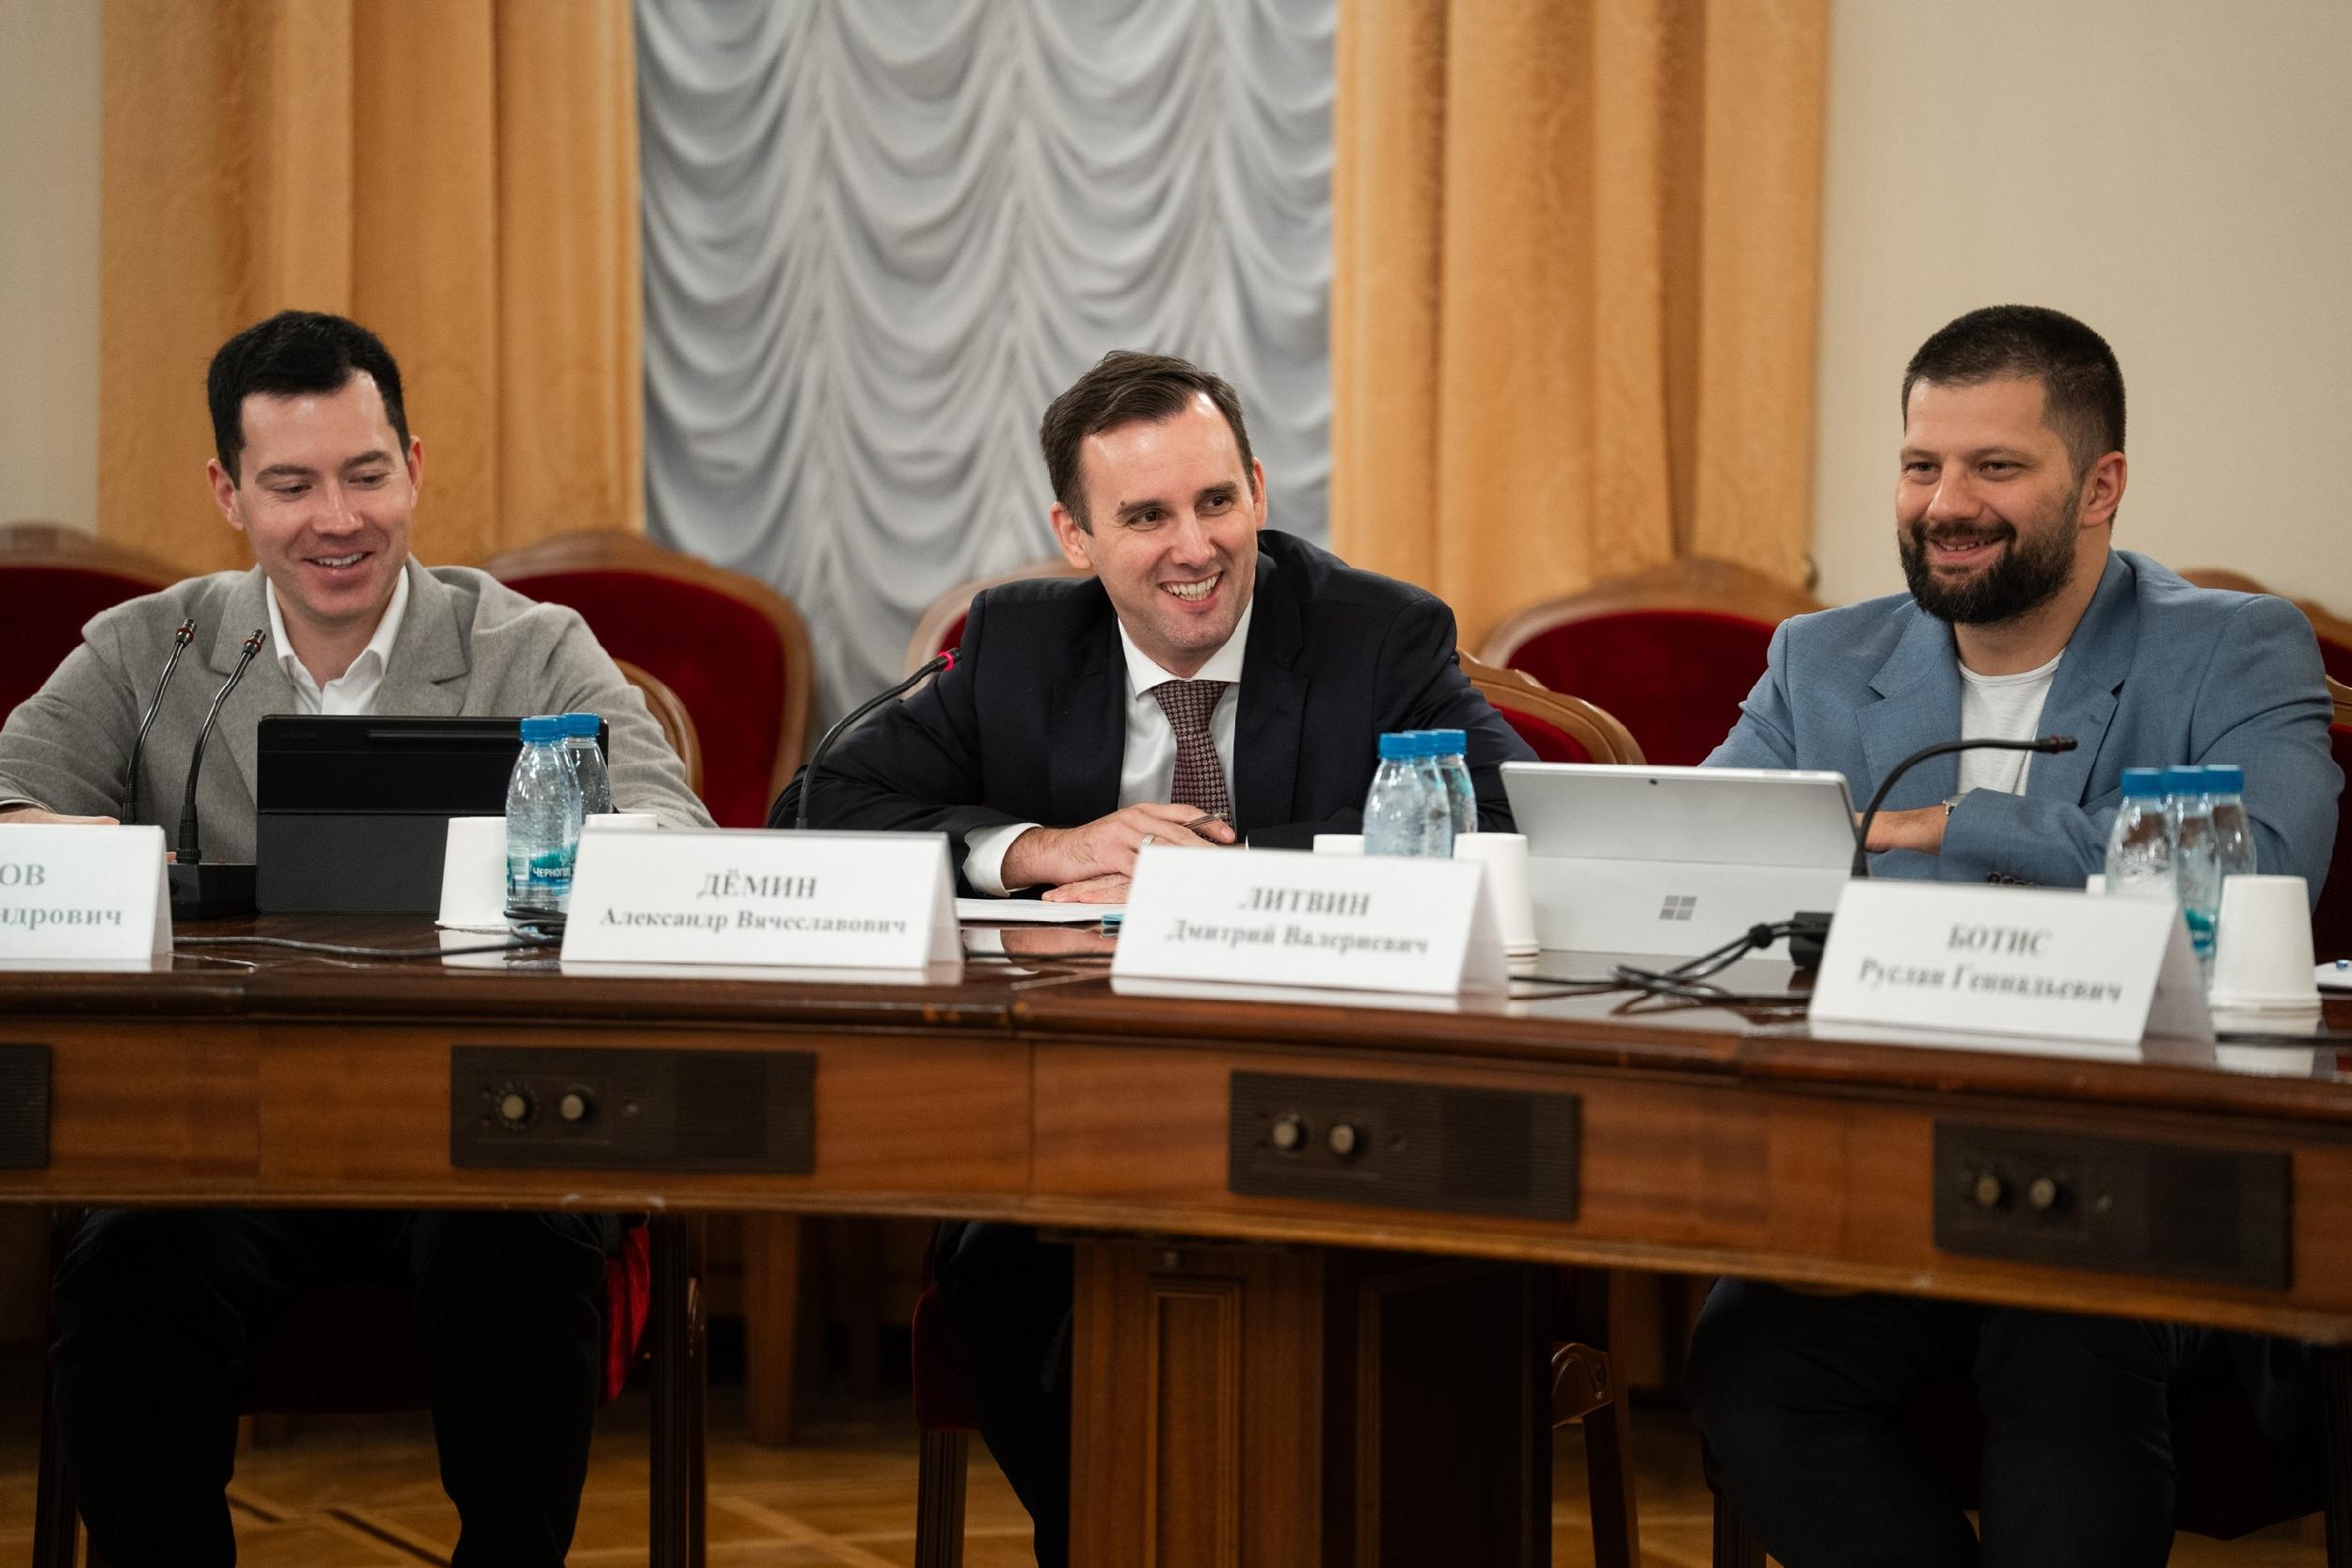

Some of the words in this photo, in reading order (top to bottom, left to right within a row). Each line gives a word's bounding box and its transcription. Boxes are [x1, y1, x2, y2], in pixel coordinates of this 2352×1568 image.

[697, 868, 818, 899] ДЁМИН
[1238, 886, 1371, 918] ЛИТВИН
[599, 907, 728, 933] Александр
[737, 909, 907, 934] Вячеславович
[1166, 918, 1276, 948] Дмитрий
[1947, 923, 2054, 957] БОТИС
[1858, 957, 1946, 991] Руслан
